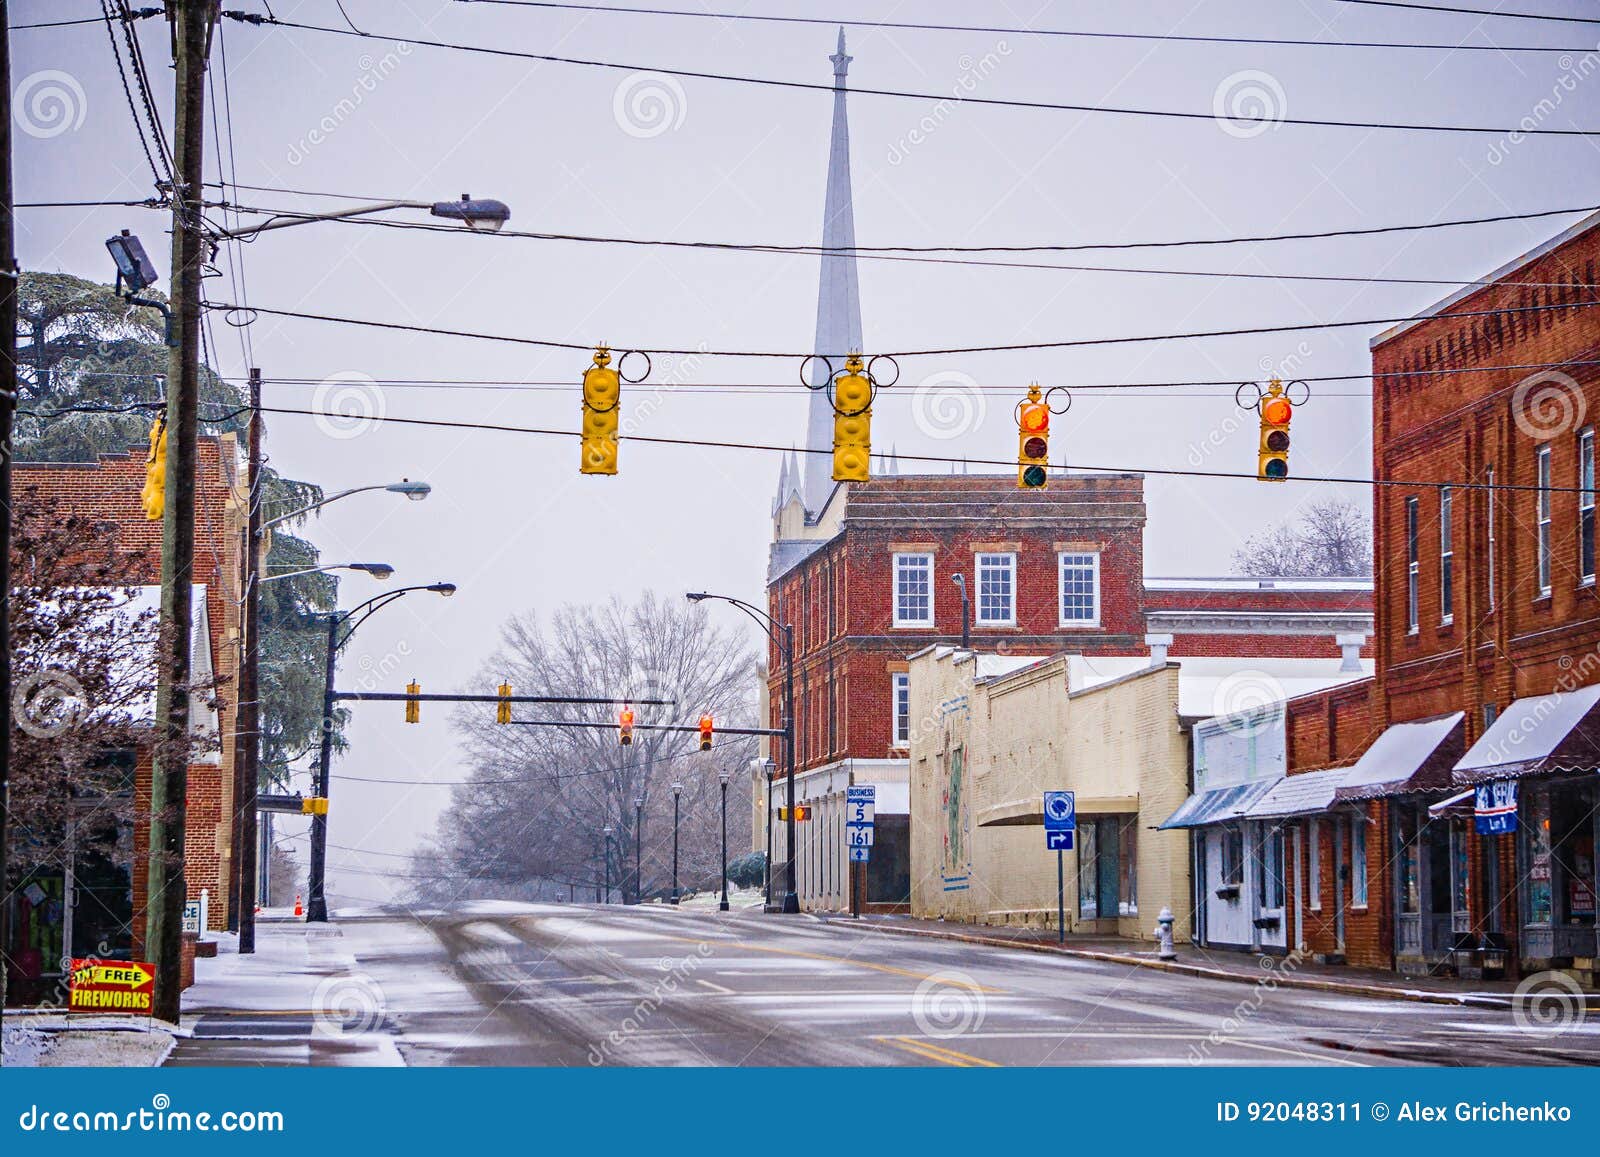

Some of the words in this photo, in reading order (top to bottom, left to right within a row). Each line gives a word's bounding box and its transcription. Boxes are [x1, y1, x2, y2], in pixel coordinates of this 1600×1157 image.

[848, 788, 874, 797] BUSINESS
[856, 808, 865, 822] 5
[851, 832, 868, 845] 161
[104, 969, 142, 982] FREE
[71, 989, 150, 1009] FIREWORKS
